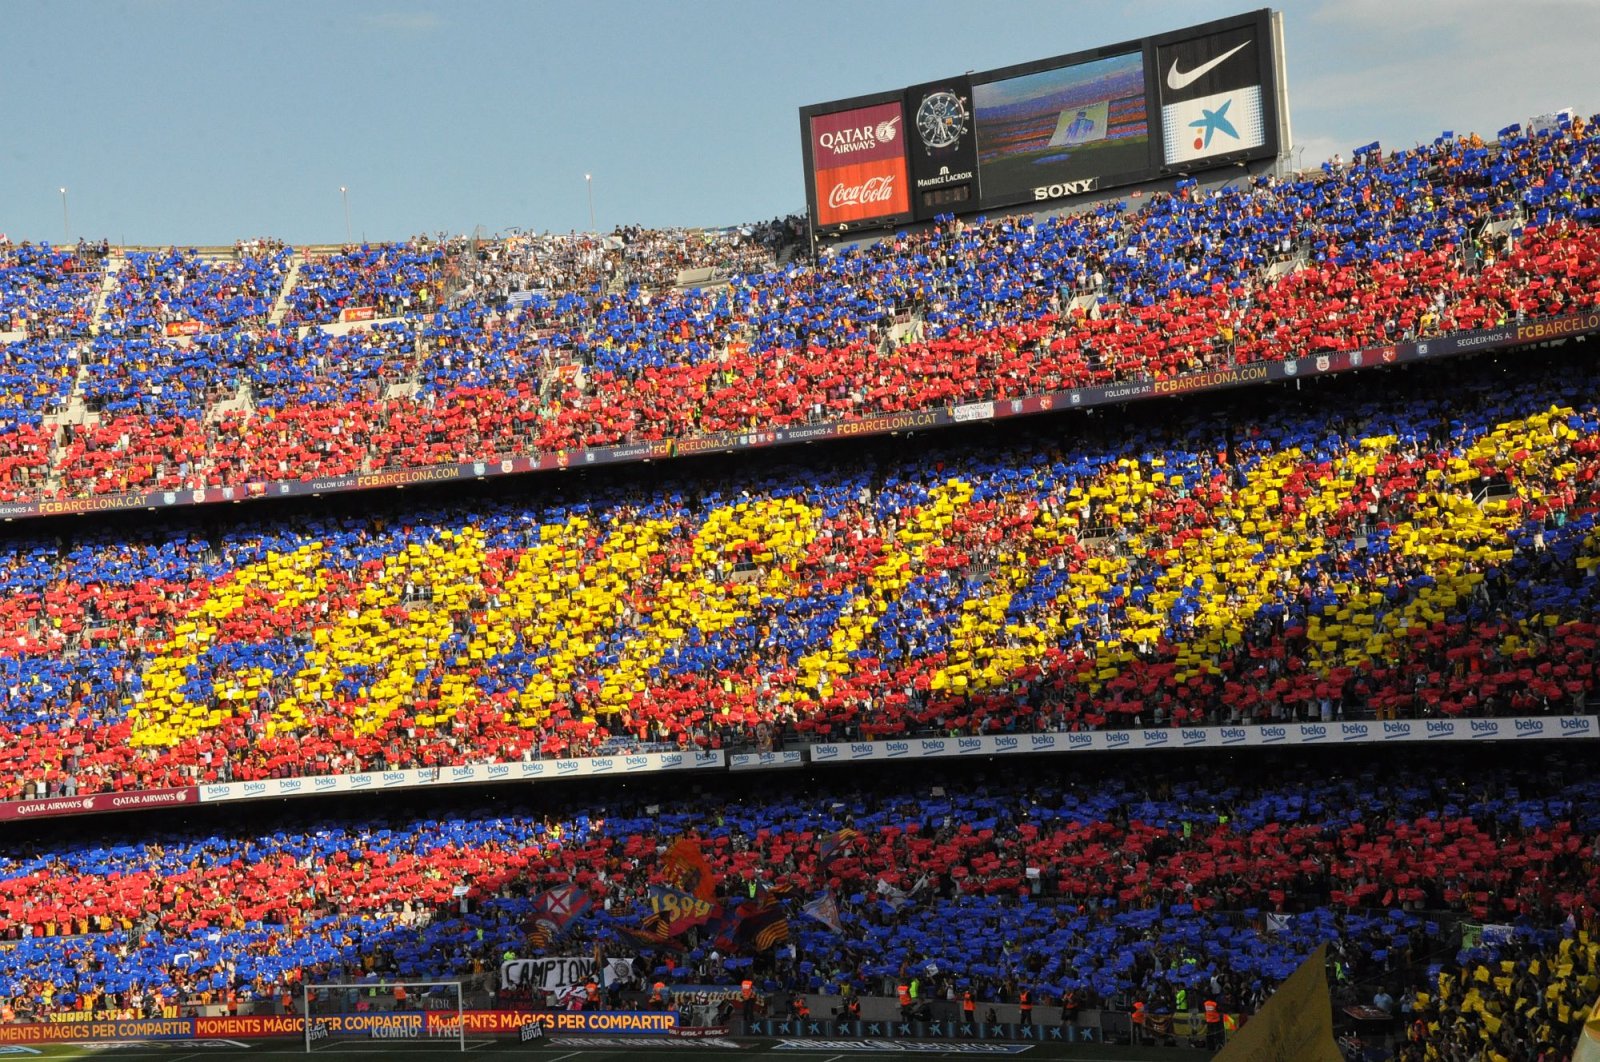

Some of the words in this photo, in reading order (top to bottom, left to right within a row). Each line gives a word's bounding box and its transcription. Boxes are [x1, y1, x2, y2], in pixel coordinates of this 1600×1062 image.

[820, 126, 873, 148] QATAR
[834, 140, 876, 154] AIRWAYS
[918, 178, 944, 187] MAURICE
[945, 172, 972, 182] LACROIX
[829, 176, 896, 208] Coca-Cola
[1034, 179, 1093, 200] SONY
[1457, 334, 1503, 347] SEGUEIX-NOS
[1105, 388, 1130, 398] FOLLOW
[1154, 367, 1267, 392] FCBARCELONA.COM
[836, 413, 938, 435] FCBARCELONA.CAT
[654, 438, 738, 454] FCRCELONA.CAT
[313, 481, 336, 489] FOLLOW
[358, 468, 459, 487] FCBARCELONA.COM
[39, 496, 147, 513] FCBARCELONA.CAT
[816, 746, 838, 754] beko
[852, 744, 873, 752] beko
[886, 742, 908, 751] beko
[922, 740, 944, 749] beko
[959, 738, 981, 747] beko
[995, 736, 1017, 746] beko
[1032, 735, 1054, 744] beko
[1069, 733, 1092, 743] beko
[1106, 732, 1129, 741] beko
[1144, 730, 1168, 740] beko
[1182, 729, 1206, 739] beko
[1221, 728, 1245, 738] beko
[1261, 726, 1285, 736] beko
[1301, 725, 1326, 735] beko
[1342, 723, 1368, 733] beko
[1384, 722, 1410, 732] beko
[1427, 721, 1454, 731] beko
[1471, 720, 1498, 731] beko
[1515, 719, 1543, 730] beko
[1561, 718, 1589, 729] beko
[208, 786, 229, 794] beko
[244, 783, 265, 791] beko
[280, 780, 300, 788] beko
[315, 777, 336, 786] beko
[351, 775, 371, 783] beko
[383, 772, 404, 780] beko
[453, 767, 474, 776] beko
[488, 765, 508, 773] beko
[522, 762, 543, 771] beko
[592, 758, 612, 767] beko
[626, 756, 647, 764] beko
[661, 754, 682, 762] beko
[696, 752, 717, 760] beko
[18, 804, 45, 814] QATAR
[47, 801, 82, 810] AIRWAYS
[113, 796, 140, 806] QATAR
[141, 793, 175, 803] AIRWAYS
[197, 1019, 260, 1033] MOMENTS
[345, 1015, 422, 1030] COMPARTIR
[558, 1014, 586, 1029] PER
[589, 1014, 674, 1029] COMPARTIR
[43, 1023, 89, 1039] MÀGICS
[93, 1024, 116, 1037] PER
[118, 1022, 190, 1036] COMPARTIR
[372, 1026, 418, 1038] KUMHO
[521, 1027, 543, 1041] BBVA
